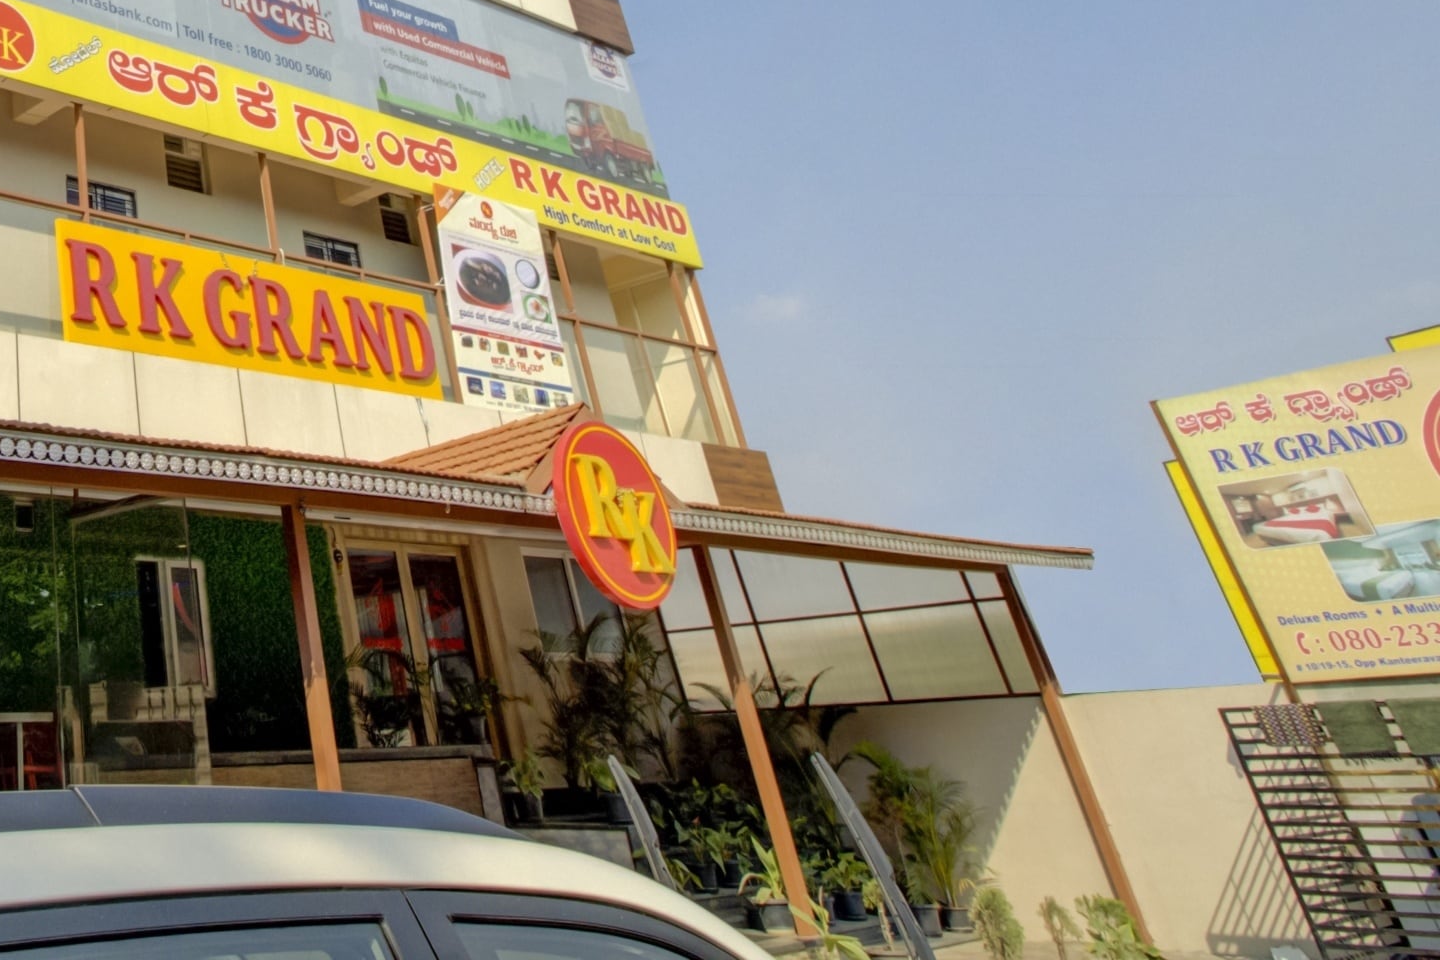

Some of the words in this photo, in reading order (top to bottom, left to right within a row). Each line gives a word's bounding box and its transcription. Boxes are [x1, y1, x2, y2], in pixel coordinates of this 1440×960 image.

[391, 6, 412, 21] your
[414, 16, 448, 33] growth
[184, 24, 205, 42] Toll
[209, 32, 233, 51] free
[244, 44, 271, 63] 1800
[274, 53, 302, 72] 3000
[306, 63, 332, 82] 5060
[373, 21, 396, 35] with
[397, 27, 420, 43] Used
[422, 37, 475, 62] Commercial
[475, 54, 506, 72] Vehicle
[108, 50, 219, 106] ಆರ್
[236, 80, 277, 129] ಕೆ
[473, 157, 506, 191] HOTEL
[543, 205, 570, 224] High
[572, 213, 616, 236] Comfort
[617, 228, 628, 239] at
[630, 229, 652, 246] Low
[653, 236, 677, 253] Cost
[576, 179, 688, 236] GRAND
[202, 268, 436, 380] GRAND
[1175, 400, 1234, 435] ಆರ್
[1245, 393, 1274, 422] ಕೆ
[1274, 419, 1407, 462] GRAND
[1277, 614, 1321, 626] Deluxe
[1322, 609, 1368, 622] Rooms
[1392, 605, 1402, 616] A
[1404, 601, 1440, 615] Multi
